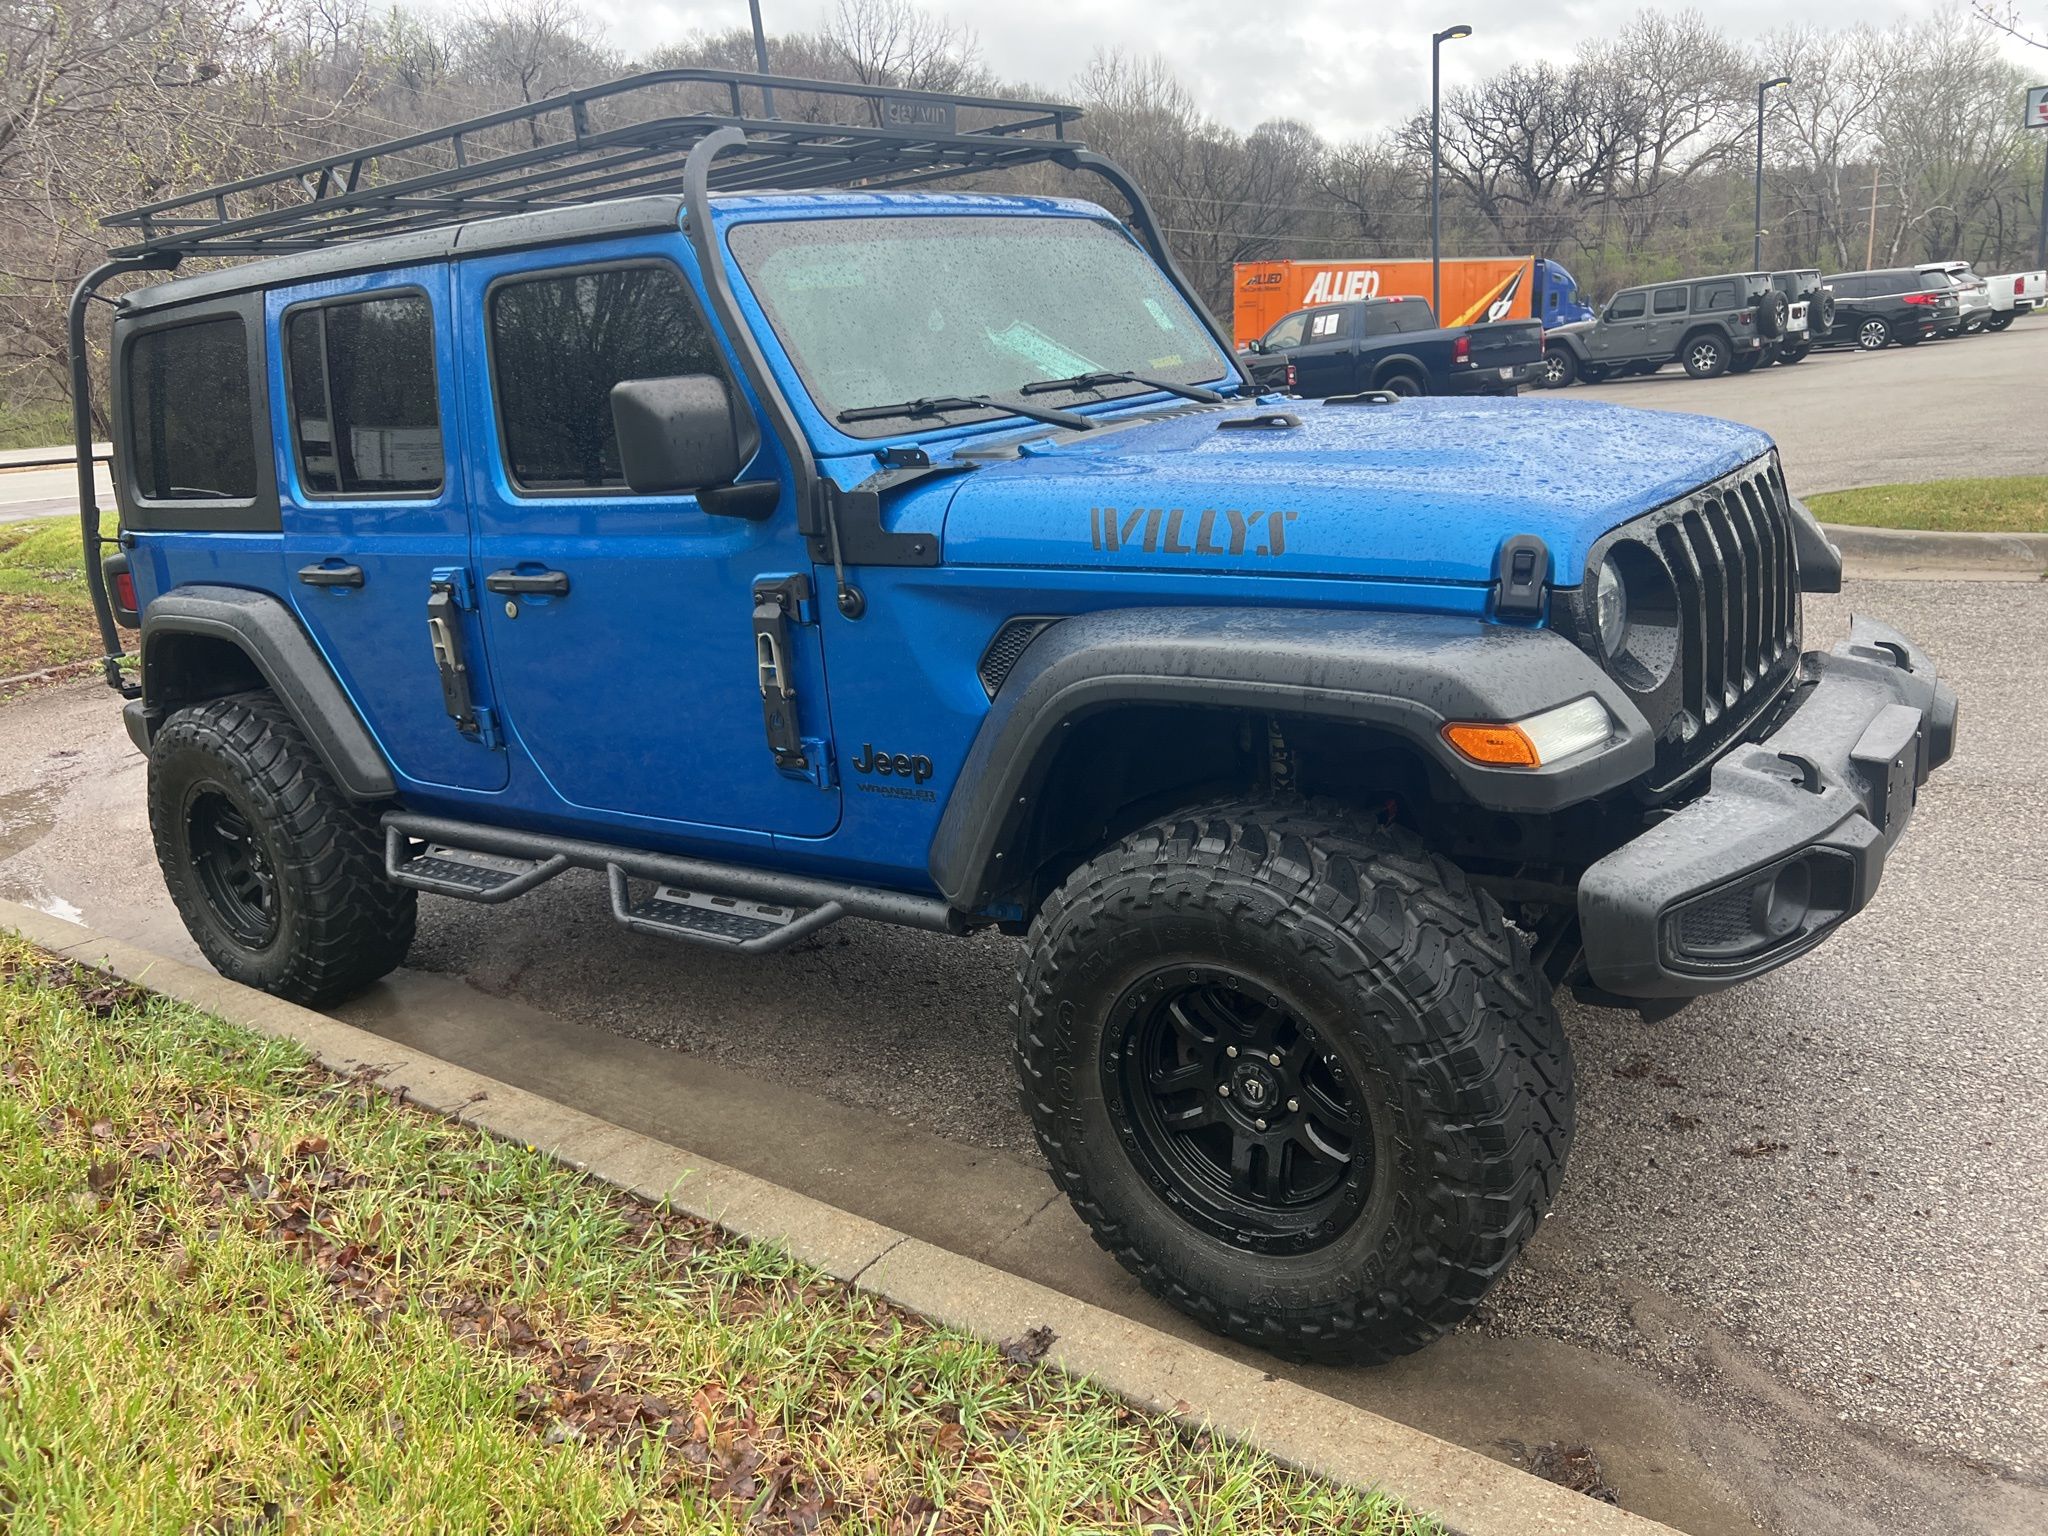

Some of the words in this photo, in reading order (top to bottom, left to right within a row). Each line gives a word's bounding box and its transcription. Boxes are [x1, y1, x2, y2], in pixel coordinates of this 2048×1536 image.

[1246, 273, 1282, 286] ALLIED
[1302, 270, 1380, 304] ALLIED
[1090, 507, 1298, 557] WILLYS
[852, 742, 933, 785] Jeep
[857, 783, 936, 800] WRANGLER
